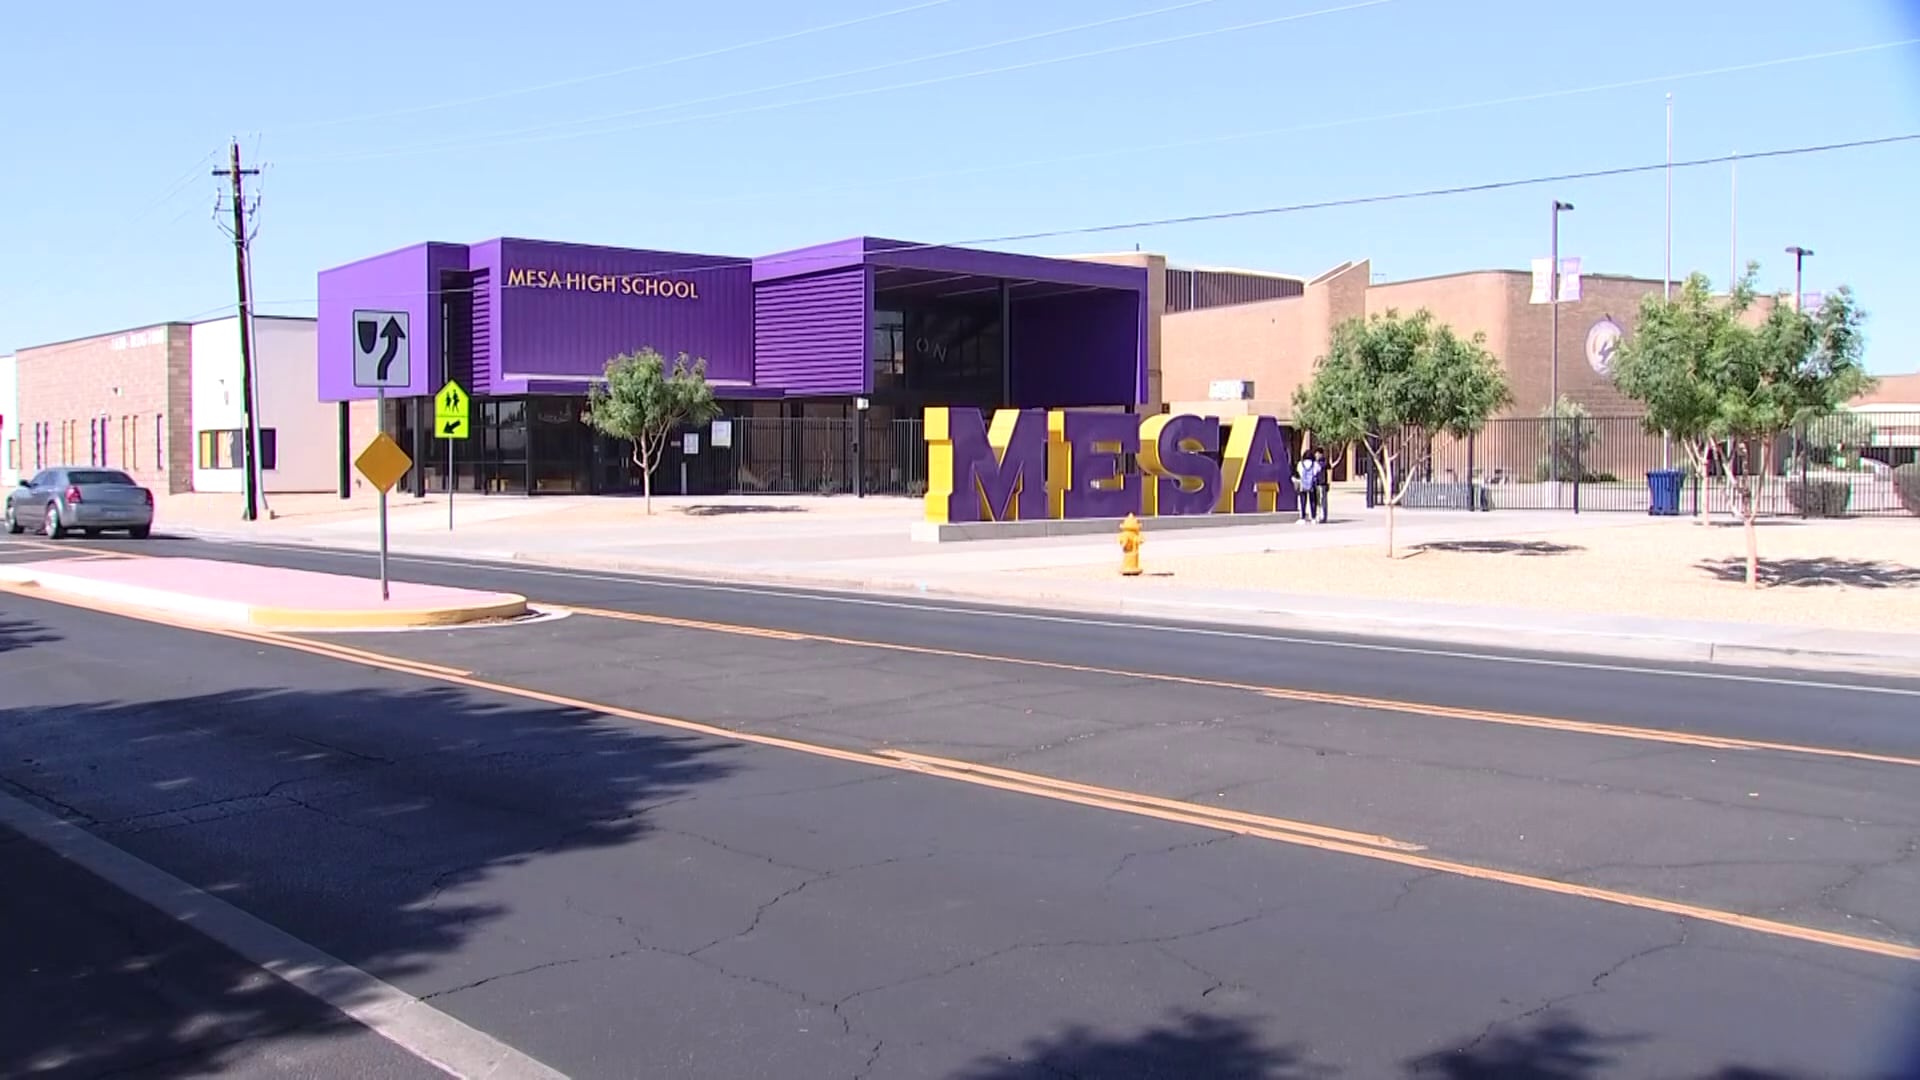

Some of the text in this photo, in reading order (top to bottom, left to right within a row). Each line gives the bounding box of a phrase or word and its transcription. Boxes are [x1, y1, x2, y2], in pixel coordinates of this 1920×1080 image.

[508, 269, 698, 299] MESA HIGH SCHOOL
[924, 407, 1299, 521] MESA
